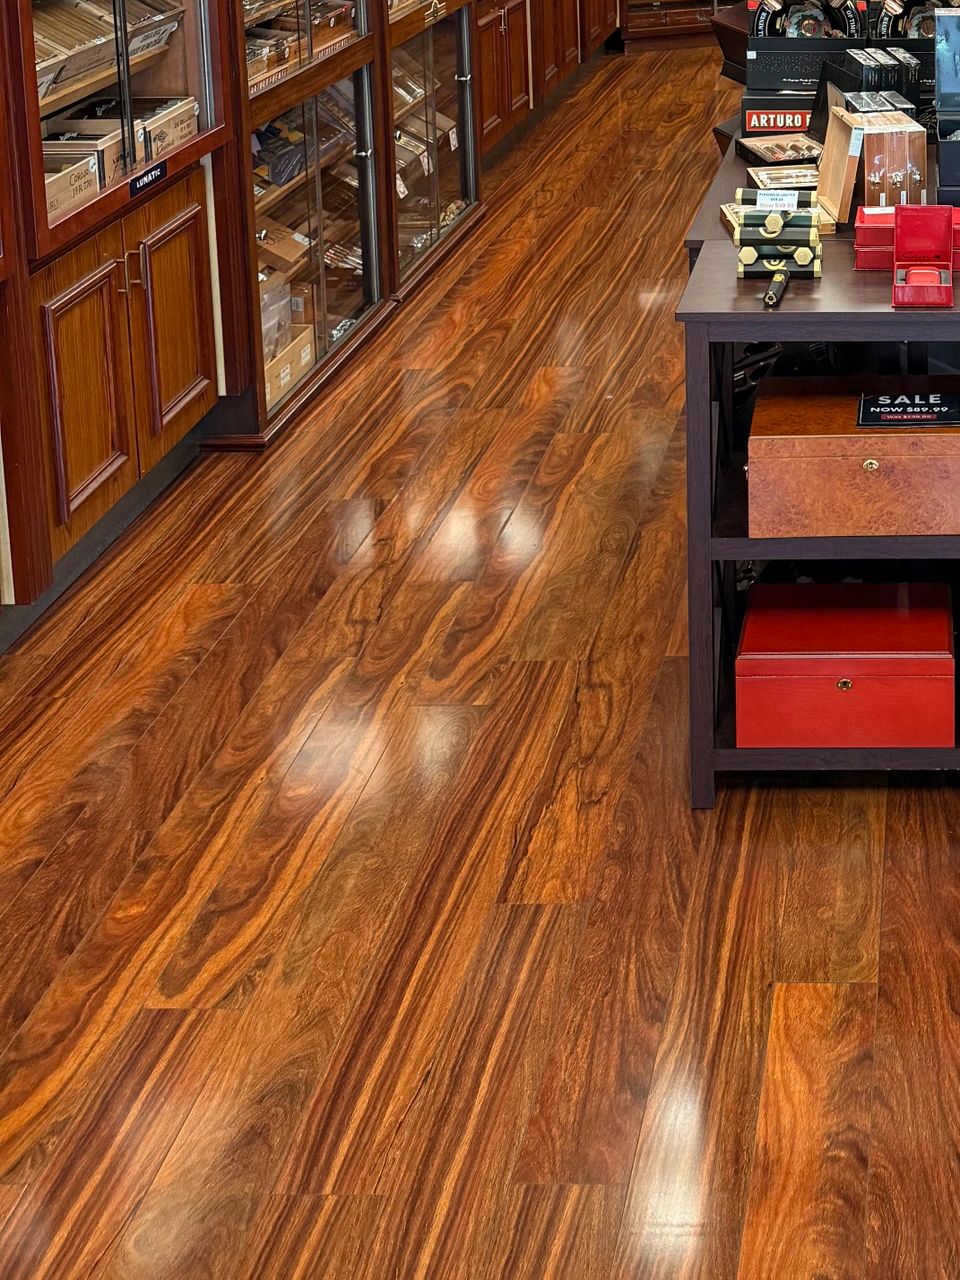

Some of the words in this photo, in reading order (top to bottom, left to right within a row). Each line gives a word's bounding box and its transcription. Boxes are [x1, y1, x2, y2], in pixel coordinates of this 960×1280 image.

[750, 113, 804, 128] ARTURO
[136, 168, 161, 189] LUNATIC
[878, 394, 942, 405] SALE
